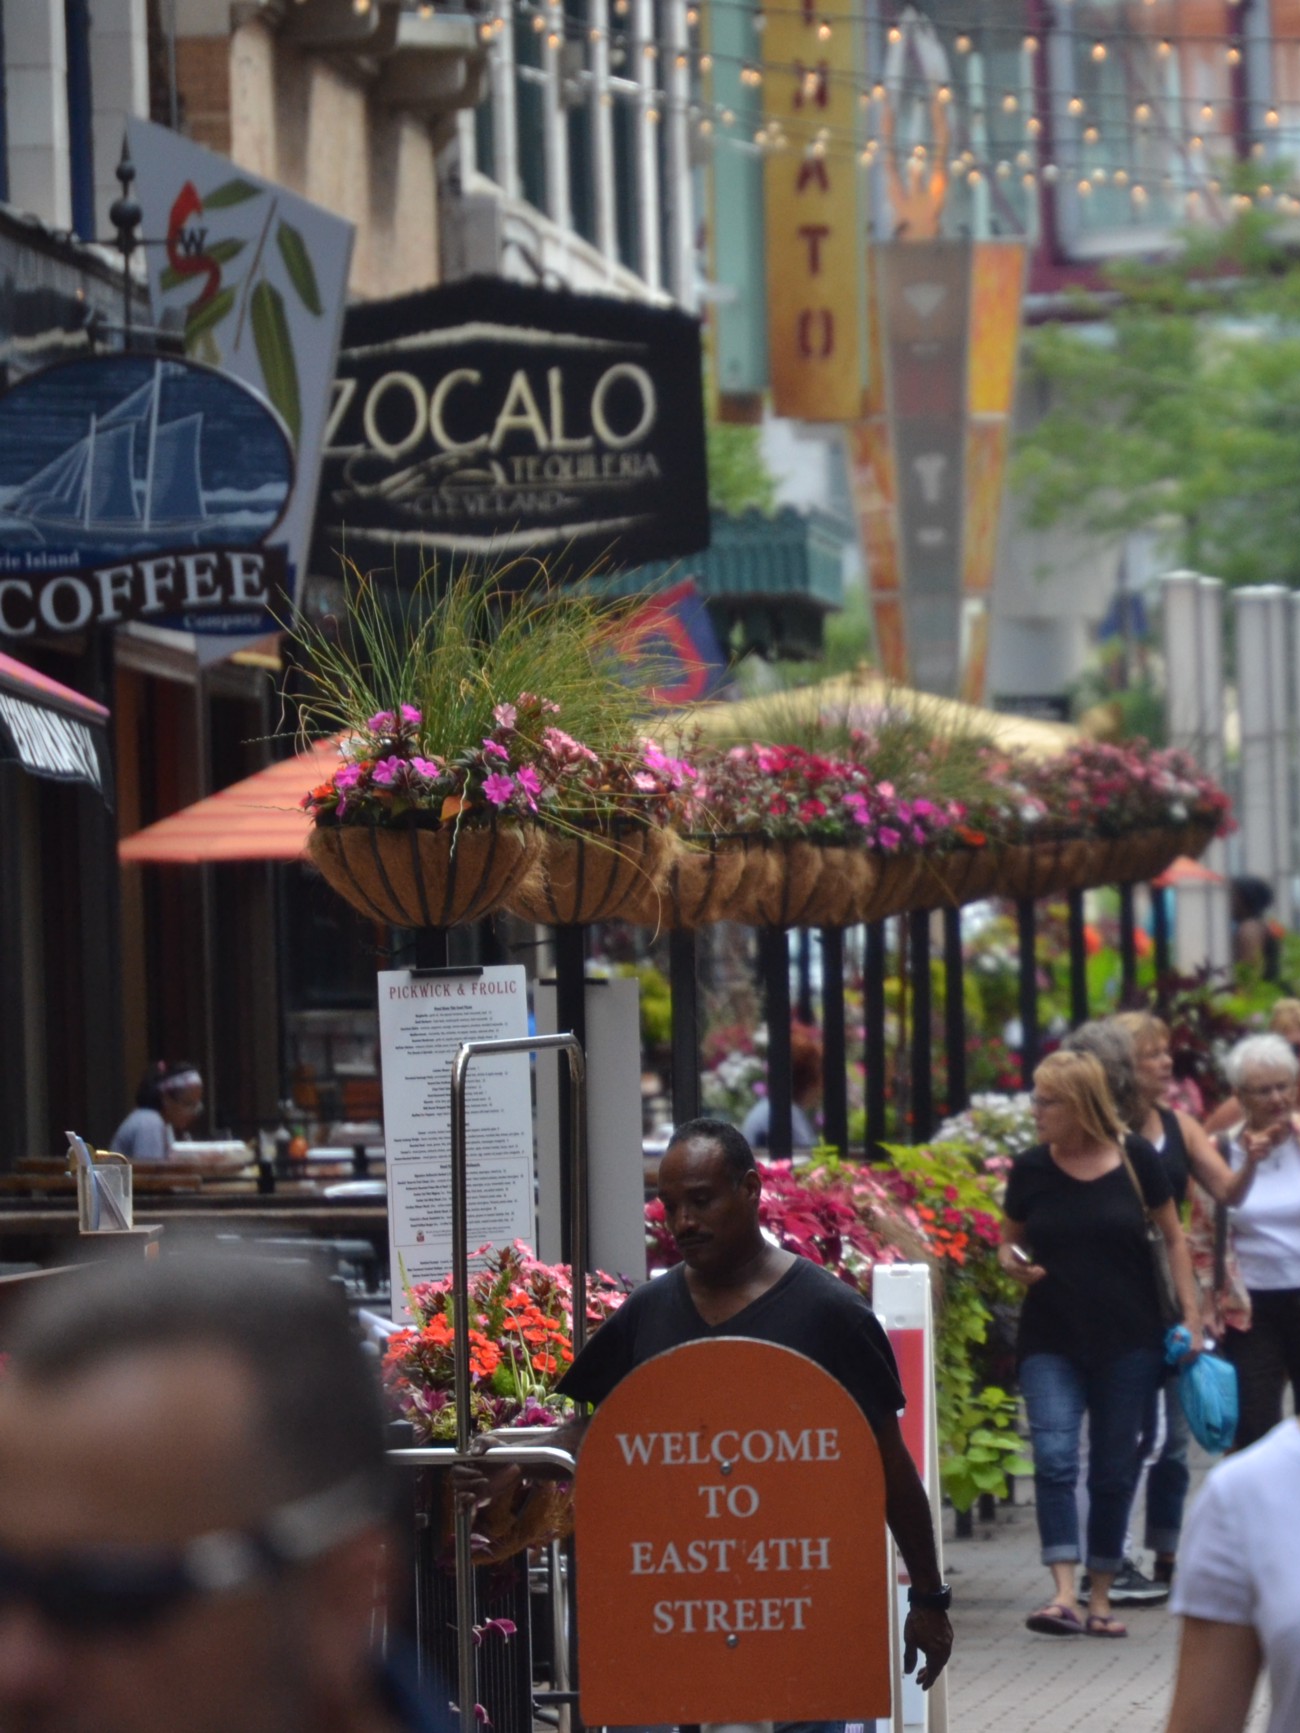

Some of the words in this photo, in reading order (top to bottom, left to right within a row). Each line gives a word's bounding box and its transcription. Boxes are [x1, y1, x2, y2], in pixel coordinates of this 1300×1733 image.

[322, 362, 657, 461] ZOCALO
[26, 550, 80, 568] Island
[0, 552, 269, 637] COFFEE
[184, 612, 261, 630] Company
[389, 982, 452, 1000] PICKWICK
[457, 983, 466, 996] &
[472, 980, 517, 996] FROLIC
[615, 1428, 841, 1466] WELCOME
[698, 1484, 760, 1518] TO
[629, 1539, 736, 1575] EAST
[747, 1537, 832, 1572] 4TH
[652, 1597, 812, 1634] STREET
